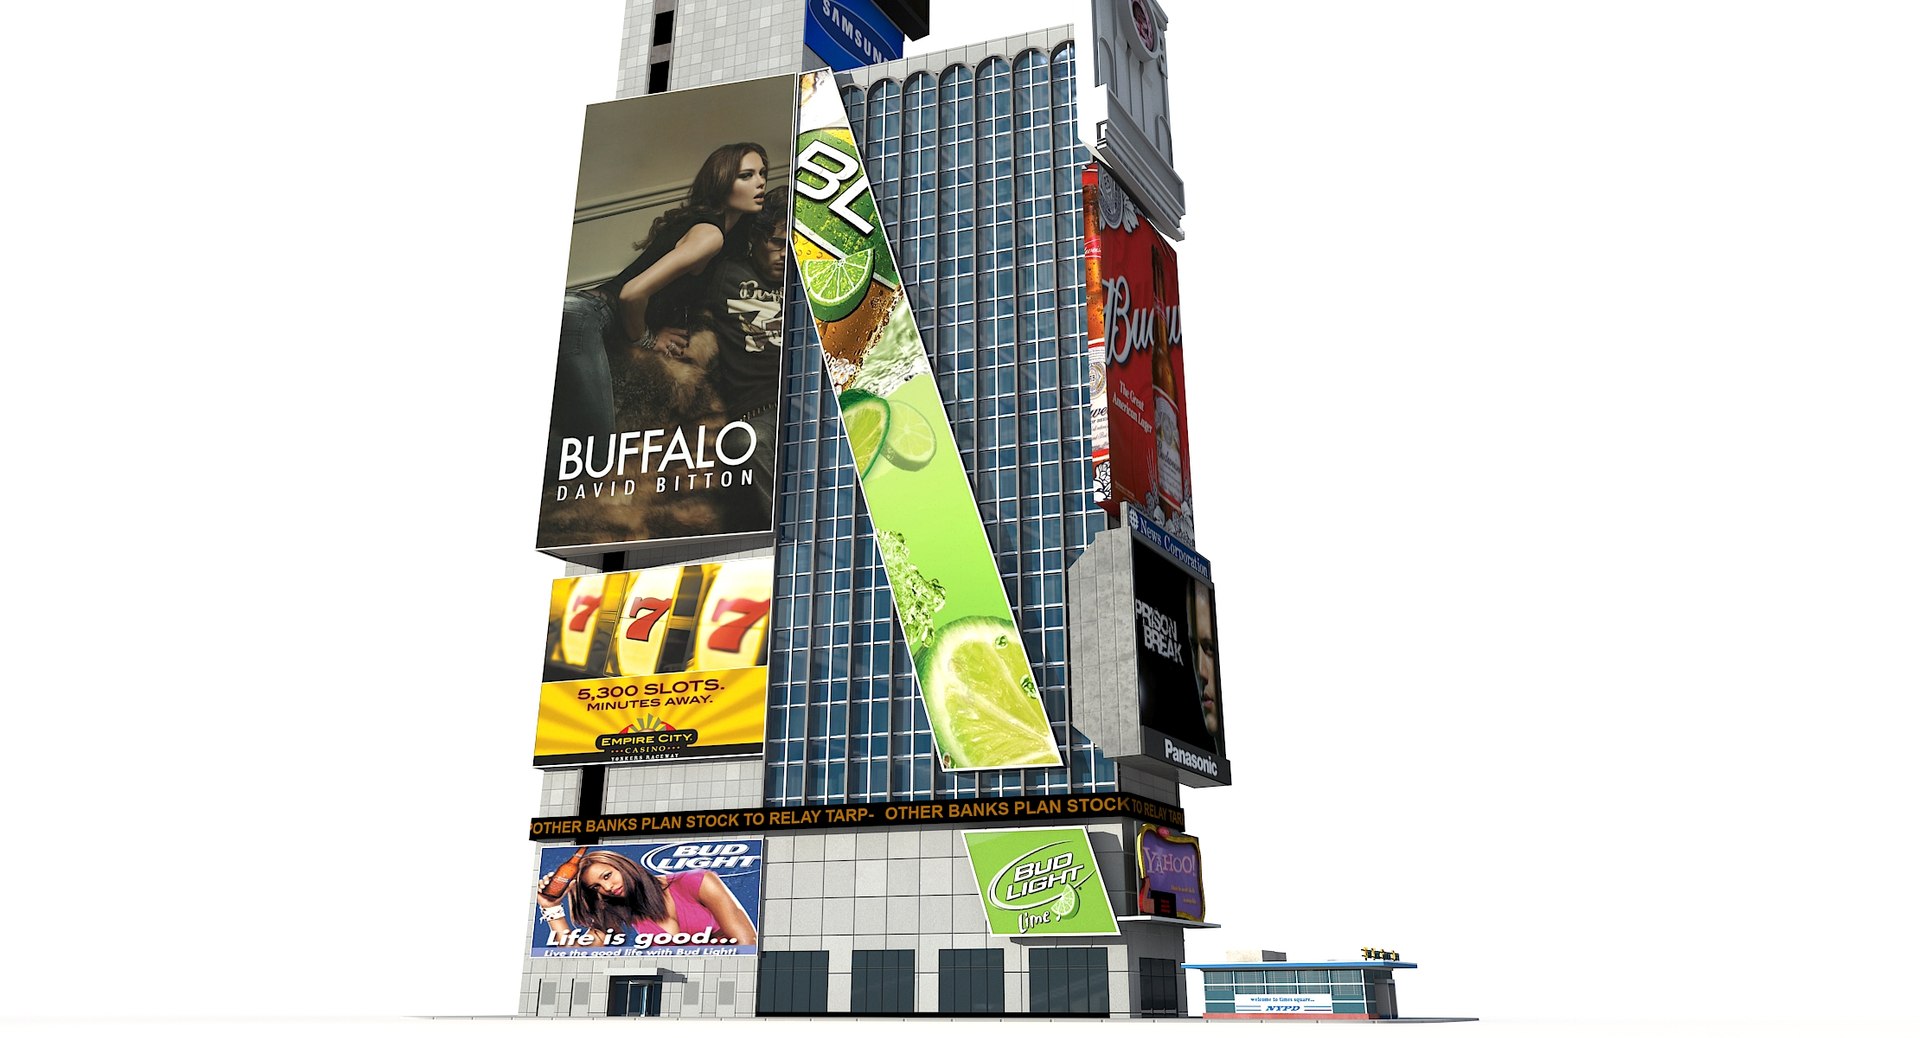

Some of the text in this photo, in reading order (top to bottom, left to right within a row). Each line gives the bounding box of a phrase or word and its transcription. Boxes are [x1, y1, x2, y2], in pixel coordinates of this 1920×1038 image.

[822, 0, 889, 64] SAMSUN
[1120, 380, 1144, 412] The Great
[1113, 392, 1152, 433] American Lager
[558, 420, 757, 481] BUFFALO
[556, 469, 753, 501] DAVID BITTON
[1140, 516, 1208, 577] News Corporation
[569, 595, 770, 653] 7 7 7
[1135, 598, 1178, 641] PRISON
[1144, 626, 1184, 666] BREAK
[577, 679, 725, 701] 5,300 SLOTS.
[587, 695, 713, 712] MINUTES AWAY.
[601, 735, 655, 747] EMPIRE
[624, 745, 666, 754] CASINO
[1164, 738, 1218, 777] Panasonic
[585, 816, 638, 833] BANKS
[641, 814, 682, 831] PLAN
[686, 813, 739, 828] STOCK
[744, 812, 765, 826] TO
[769, 810, 822, 825] RELAY
[885, 804, 944, 821] OTHER
[949, 802, 1009, 818] BANKS
[1014, 800, 1062, 816] PLAN
[1067, 796, 1131, 813] STOCK
[1132, 798, 1142, 814] TO
[1143, 802, 1167, 820] RELAY
[655, 855, 760, 869] LIGHT
[672, 843, 750, 858] BUD
[1143, 847, 1196, 877] YAHOO!
[1005, 864, 1085, 902] LIGHT
[1013, 851, 1074, 883] BUD
[544, 946, 738, 957] Live the good life with Bud Light!
[546, 926, 595, 947] Life
[603, 928, 625, 946] is
